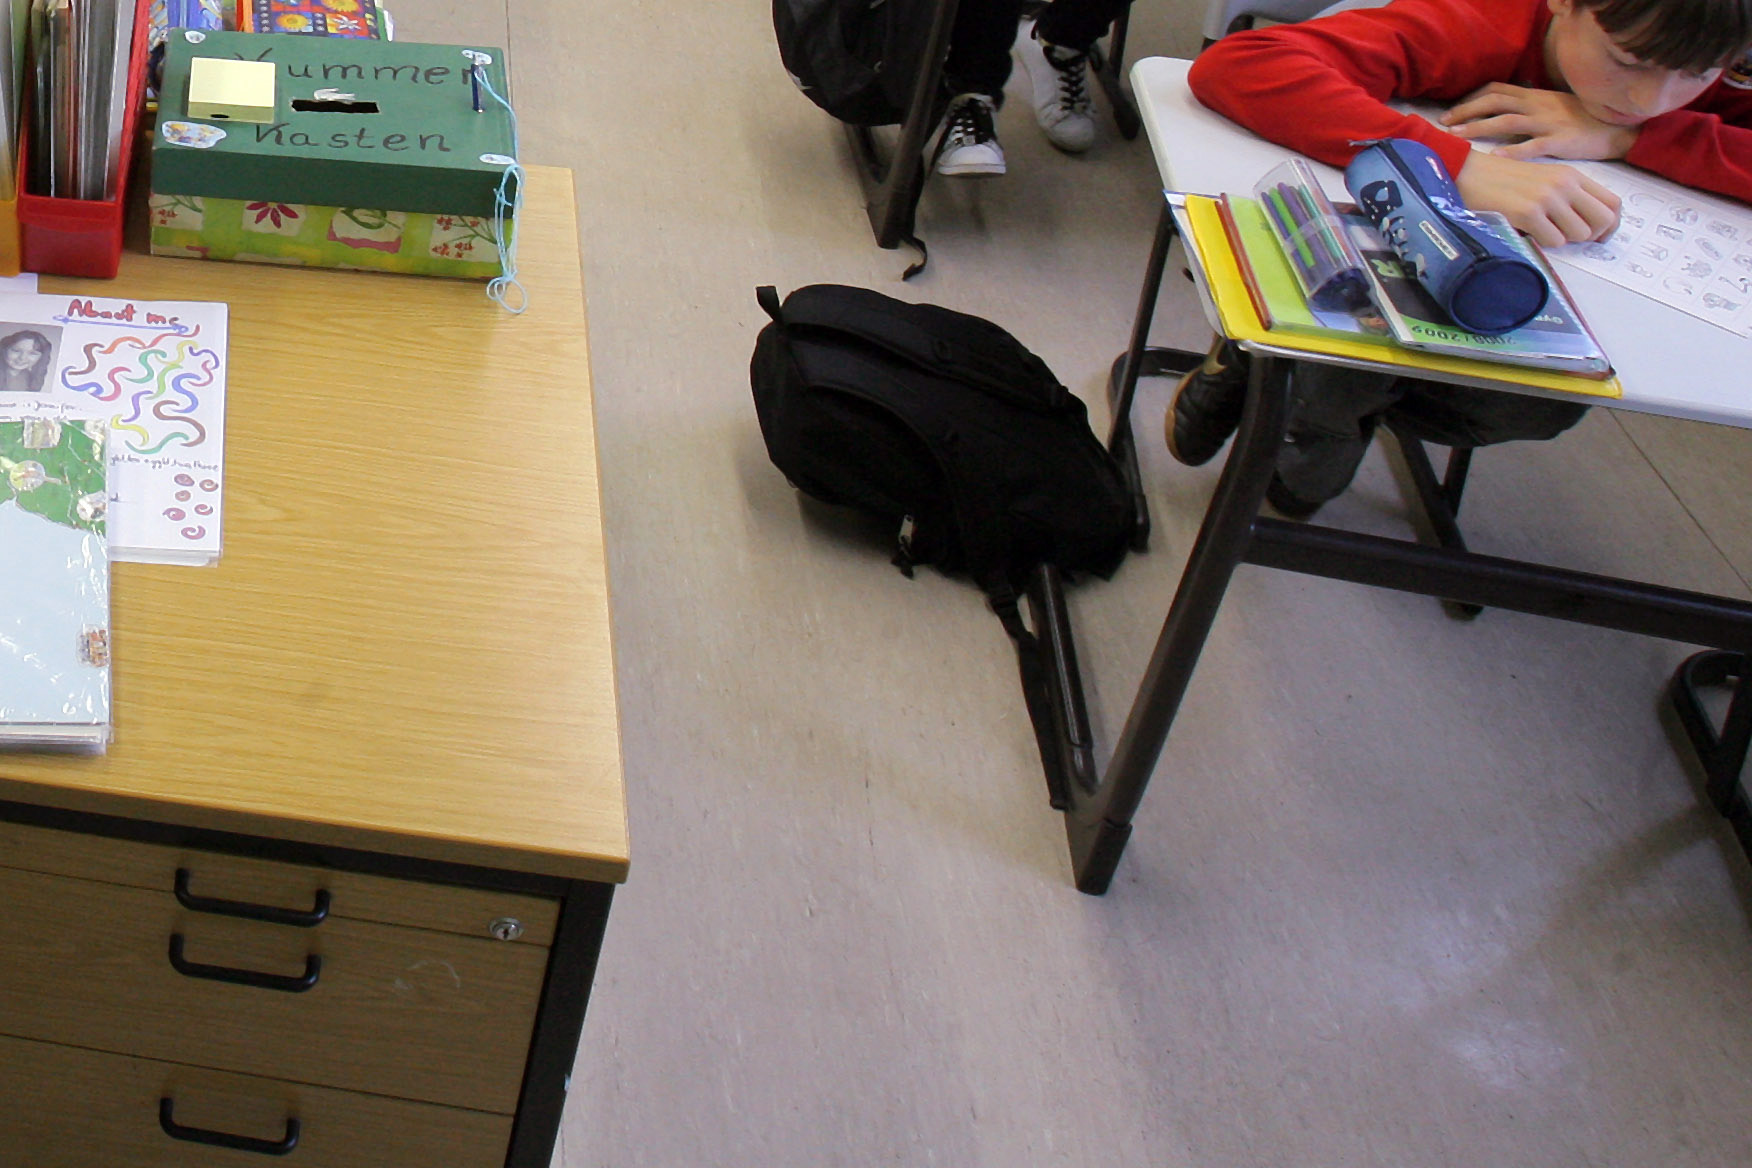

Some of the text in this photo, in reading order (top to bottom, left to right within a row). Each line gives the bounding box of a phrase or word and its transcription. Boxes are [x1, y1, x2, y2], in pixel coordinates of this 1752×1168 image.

[234, 48, 473, 85] ummer
[254, 123, 452, 153] Kasten
[67, 299, 180, 326] About me
